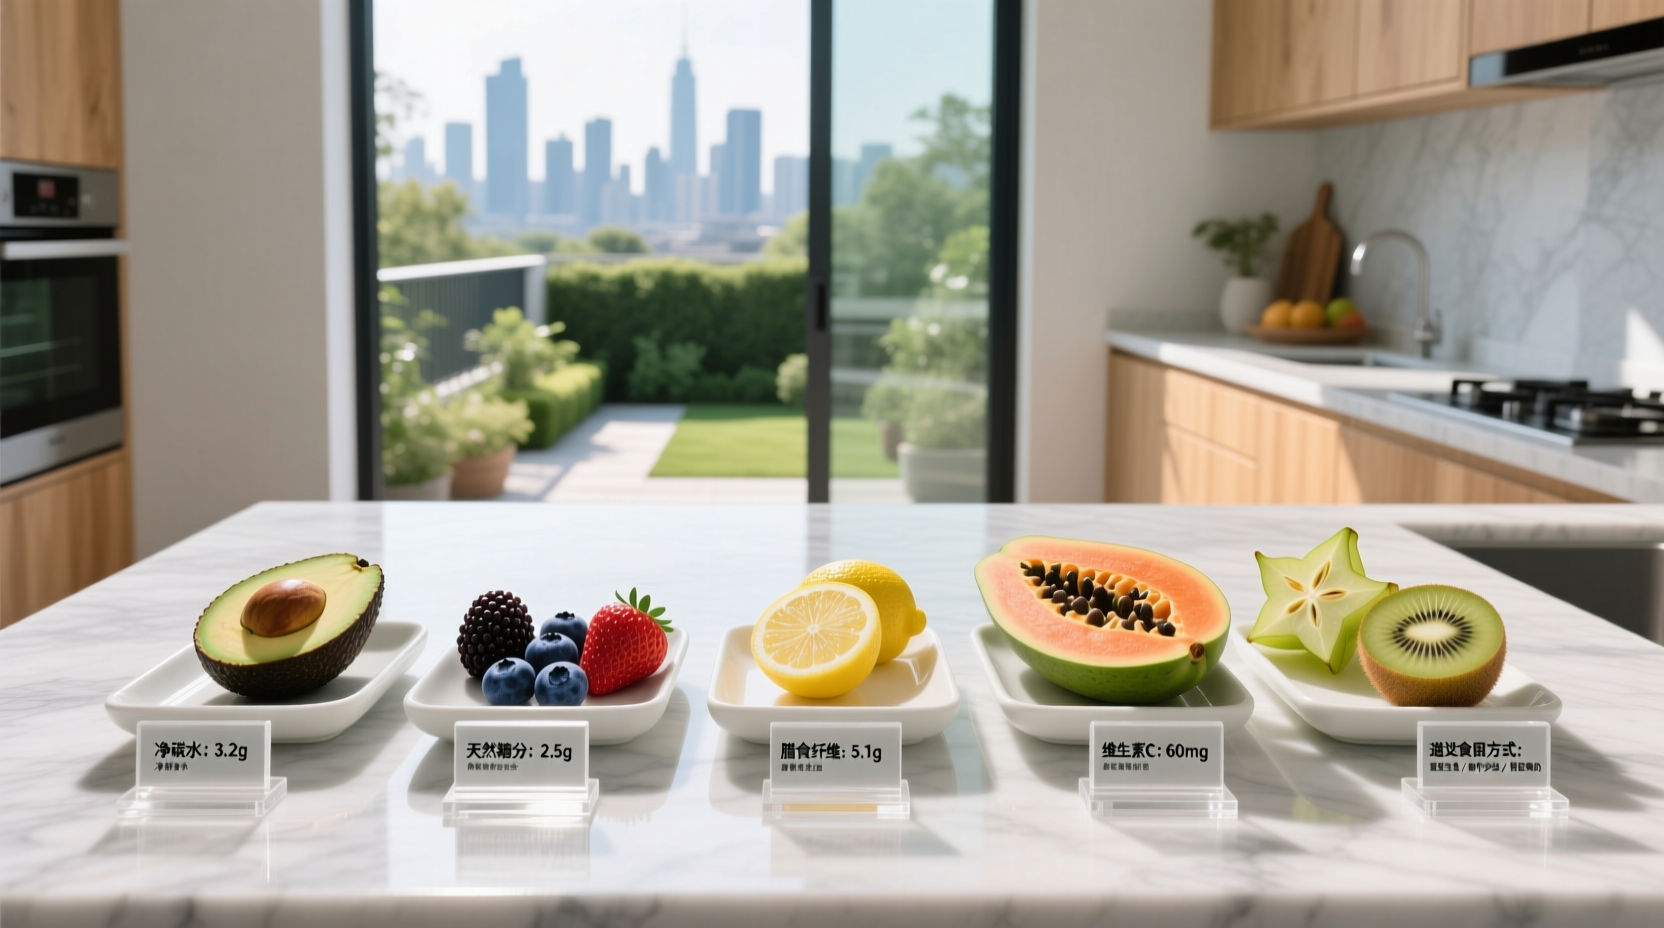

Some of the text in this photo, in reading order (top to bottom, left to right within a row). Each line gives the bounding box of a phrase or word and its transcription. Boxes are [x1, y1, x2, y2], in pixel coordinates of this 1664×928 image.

[214, 742, 248, 761] 3.2g
[540, 743, 572, 762] 2.5g
[851, 744, 882, 763] 5.1g
[1166, 743, 1209, 762] 60mg
